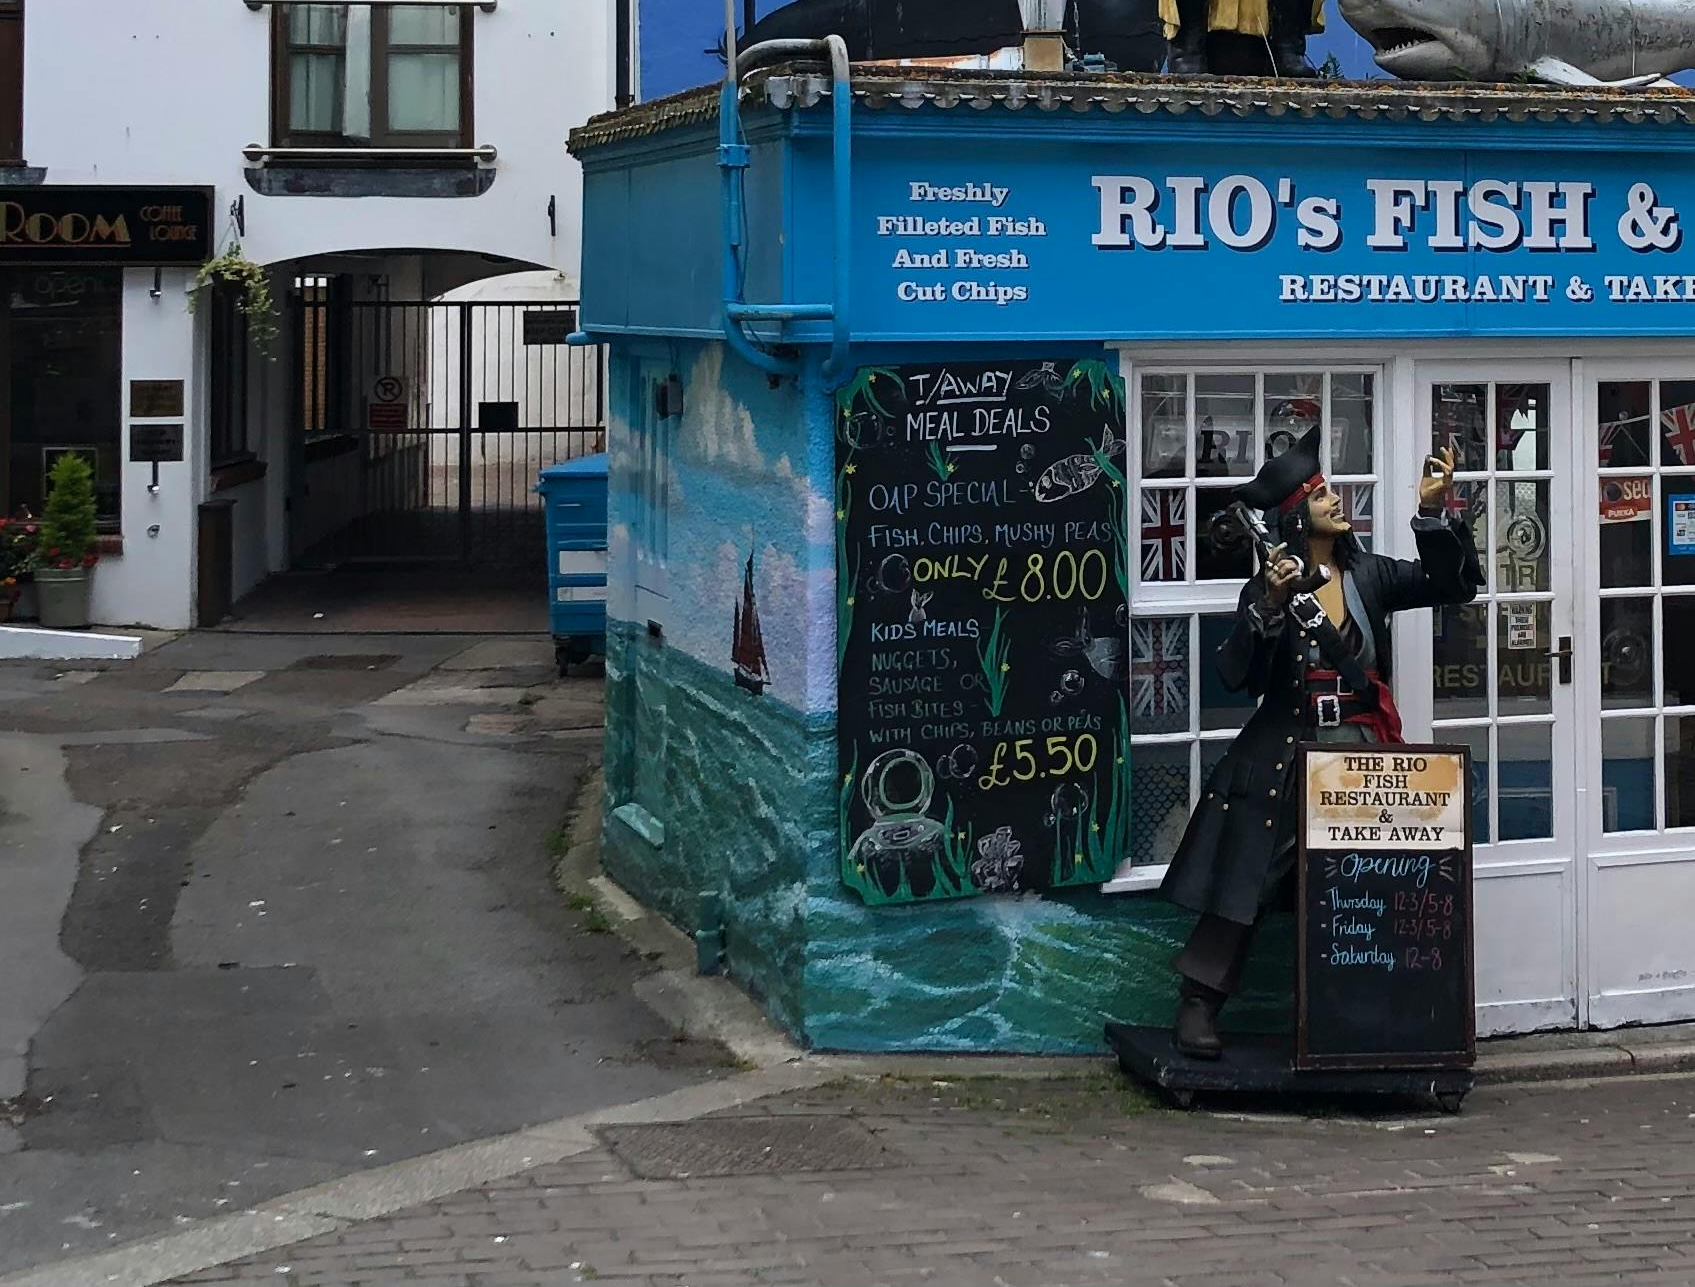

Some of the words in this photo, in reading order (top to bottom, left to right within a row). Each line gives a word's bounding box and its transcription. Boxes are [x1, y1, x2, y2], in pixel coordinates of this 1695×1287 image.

[909, 182, 1009, 206] Freshly
[1091, 174, 1339, 251] RIO's
[1366, 179, 1598, 251] FISH
[1616, 182, 1680, 252] &
[877, 216, 981, 237] Filleted
[987, 216, 1046, 237] Fish
[892, 249, 951, 270] And
[955, 248, 1029, 270] Fresh
[897, 280, 948, 302] Cut
[951, 280, 1029, 305] Chips
[1279, 274, 1553, 302] RESTAURANT
[1565, 275, 1594, 302] &
[906, 409, 966, 442] MEAL
[971, 405, 1051, 438] DEALS
[868, 483, 918, 515] OAP
[923, 479, 1017, 509] SPECIAL
[994, 522, 1056, 548] MUSHY
[1064, 521, 1113, 543] PEAS
[912, 553, 990, 583] ONLY
[981, 548, 1107, 603] £8.00
[871, 621, 917, 643] KIDS
[923, 618, 980, 639] MEALS
[868, 675, 944, 696] SAUSAGE
[867, 701, 907, 719] FISH
[868, 726, 911, 744] WITH
[982, 717, 1036, 738] BEANS
[1041, 715, 1062, 732] OR
[978, 733, 1098, 790] £5.50
[1344, 756, 1384, 772] THE
[1392, 756, 1428, 772] RIO
[1363, 774, 1408, 789] FISH
[1319, 791, 1450, 807] RESTAURANT
[1378, 808, 1394, 824] &
[1328, 826, 1381, 842] TAKE
[1387, 826, 1446, 842] AWAY
[1340, 852, 1436, 888] Opening
[1326, 885, 1386, 915] Thursday
[1332, 914, 1376, 941] Friday
[1330, 942, 1396, 972] Saturday
